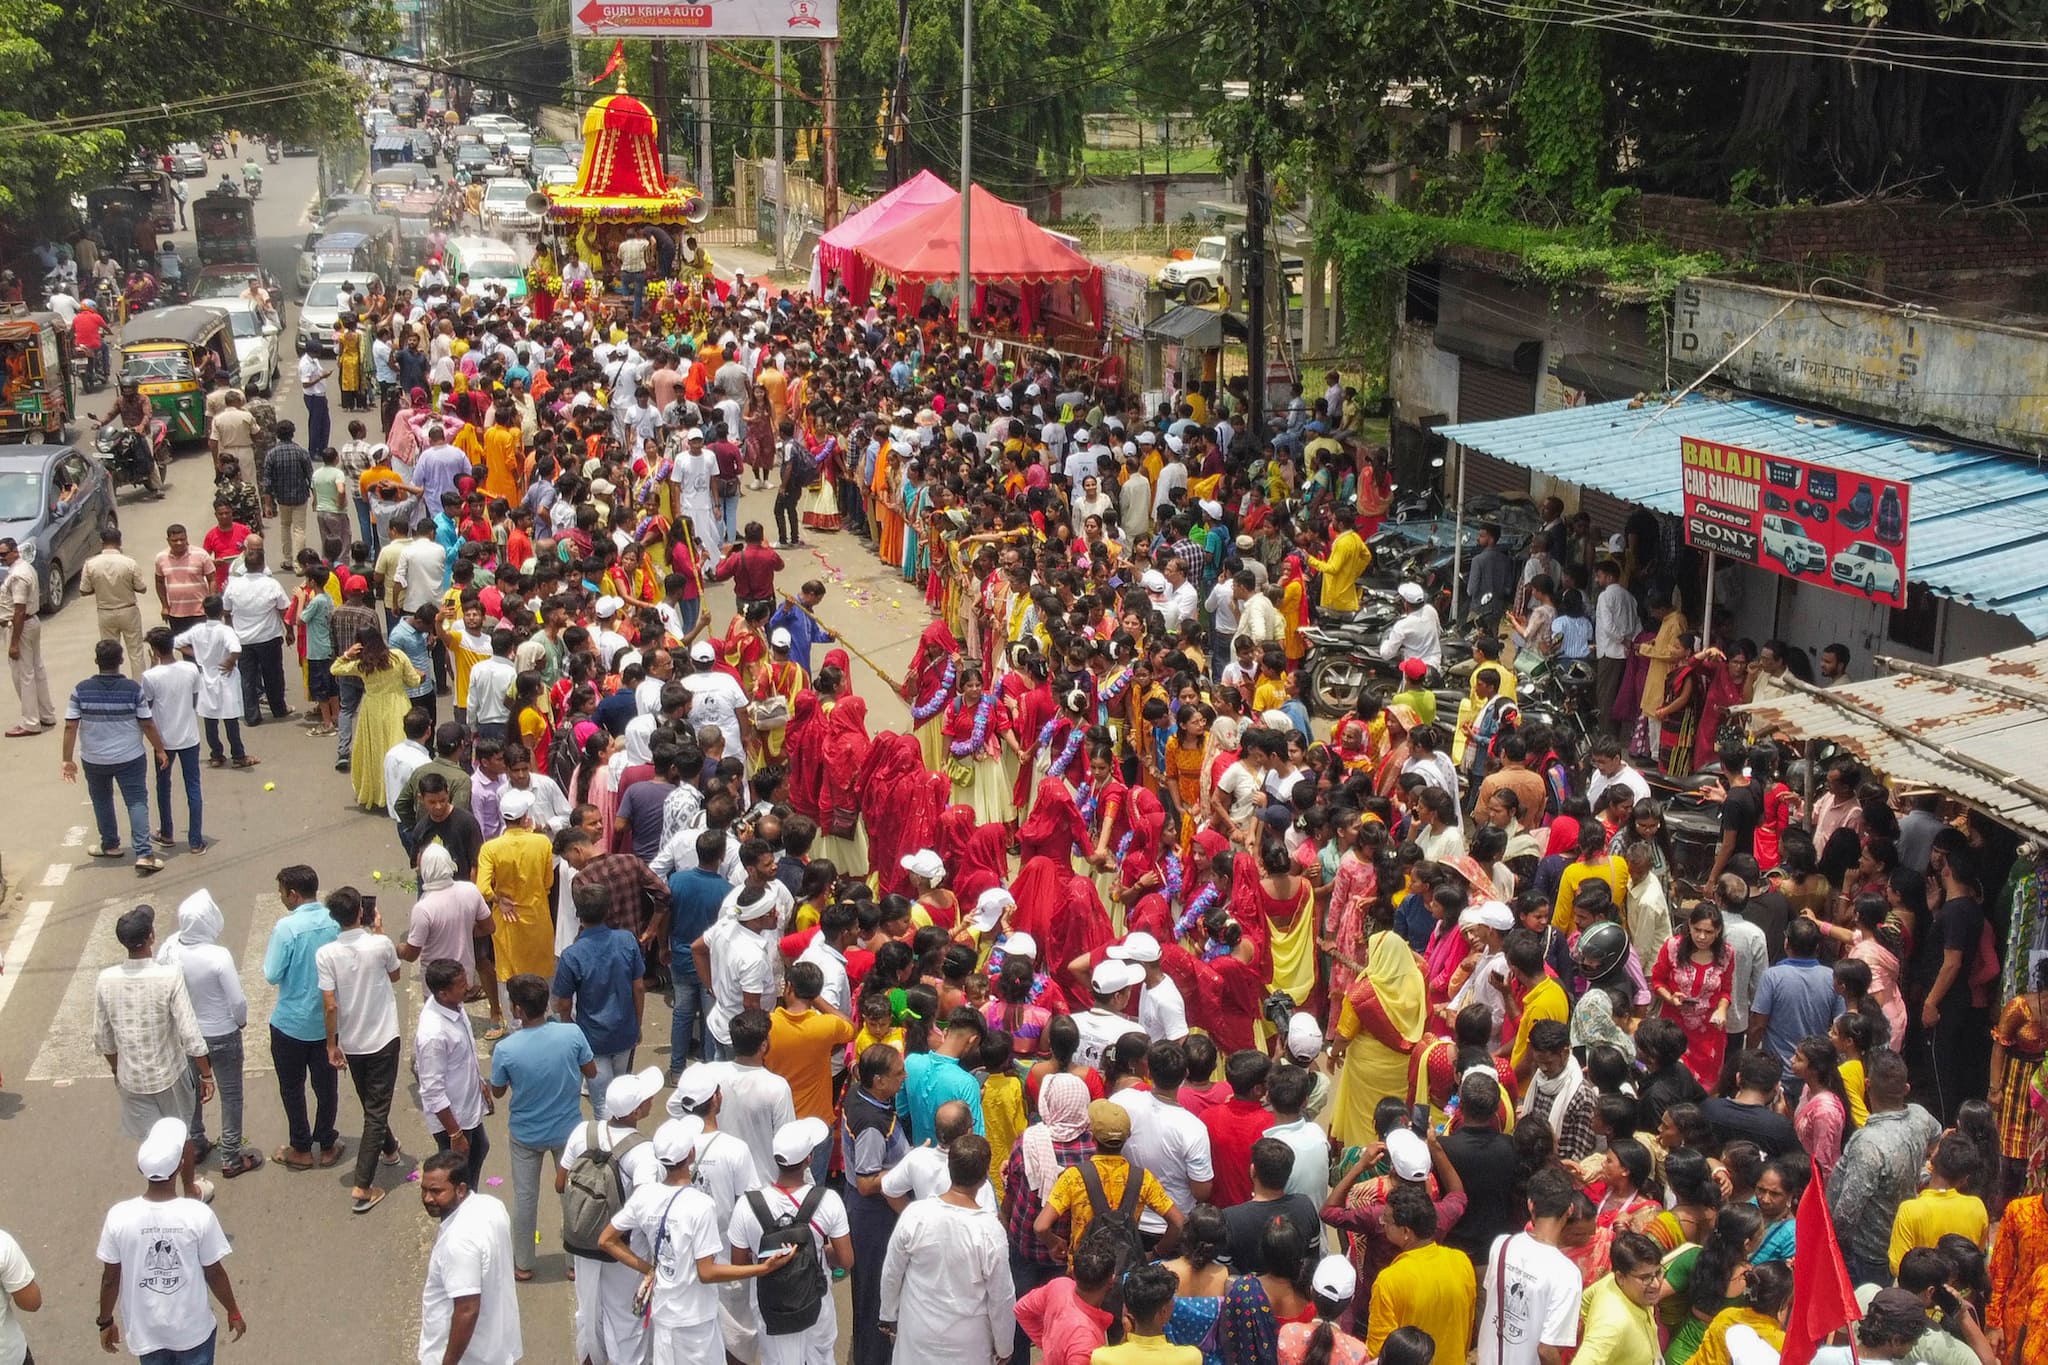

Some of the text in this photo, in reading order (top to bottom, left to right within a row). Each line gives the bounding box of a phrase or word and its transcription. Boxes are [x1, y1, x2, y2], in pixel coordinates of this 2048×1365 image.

[603, 6, 704, 17] GURU KRIPA AUTO
[1681, 287, 1702, 351] STD
[1682, 441, 1762, 481] BALAJI
[1684, 468, 1761, 512] CAR SAJAWAT
[1695, 502, 1751, 527] Pioneer
[1690, 518, 1757, 549] SONY
